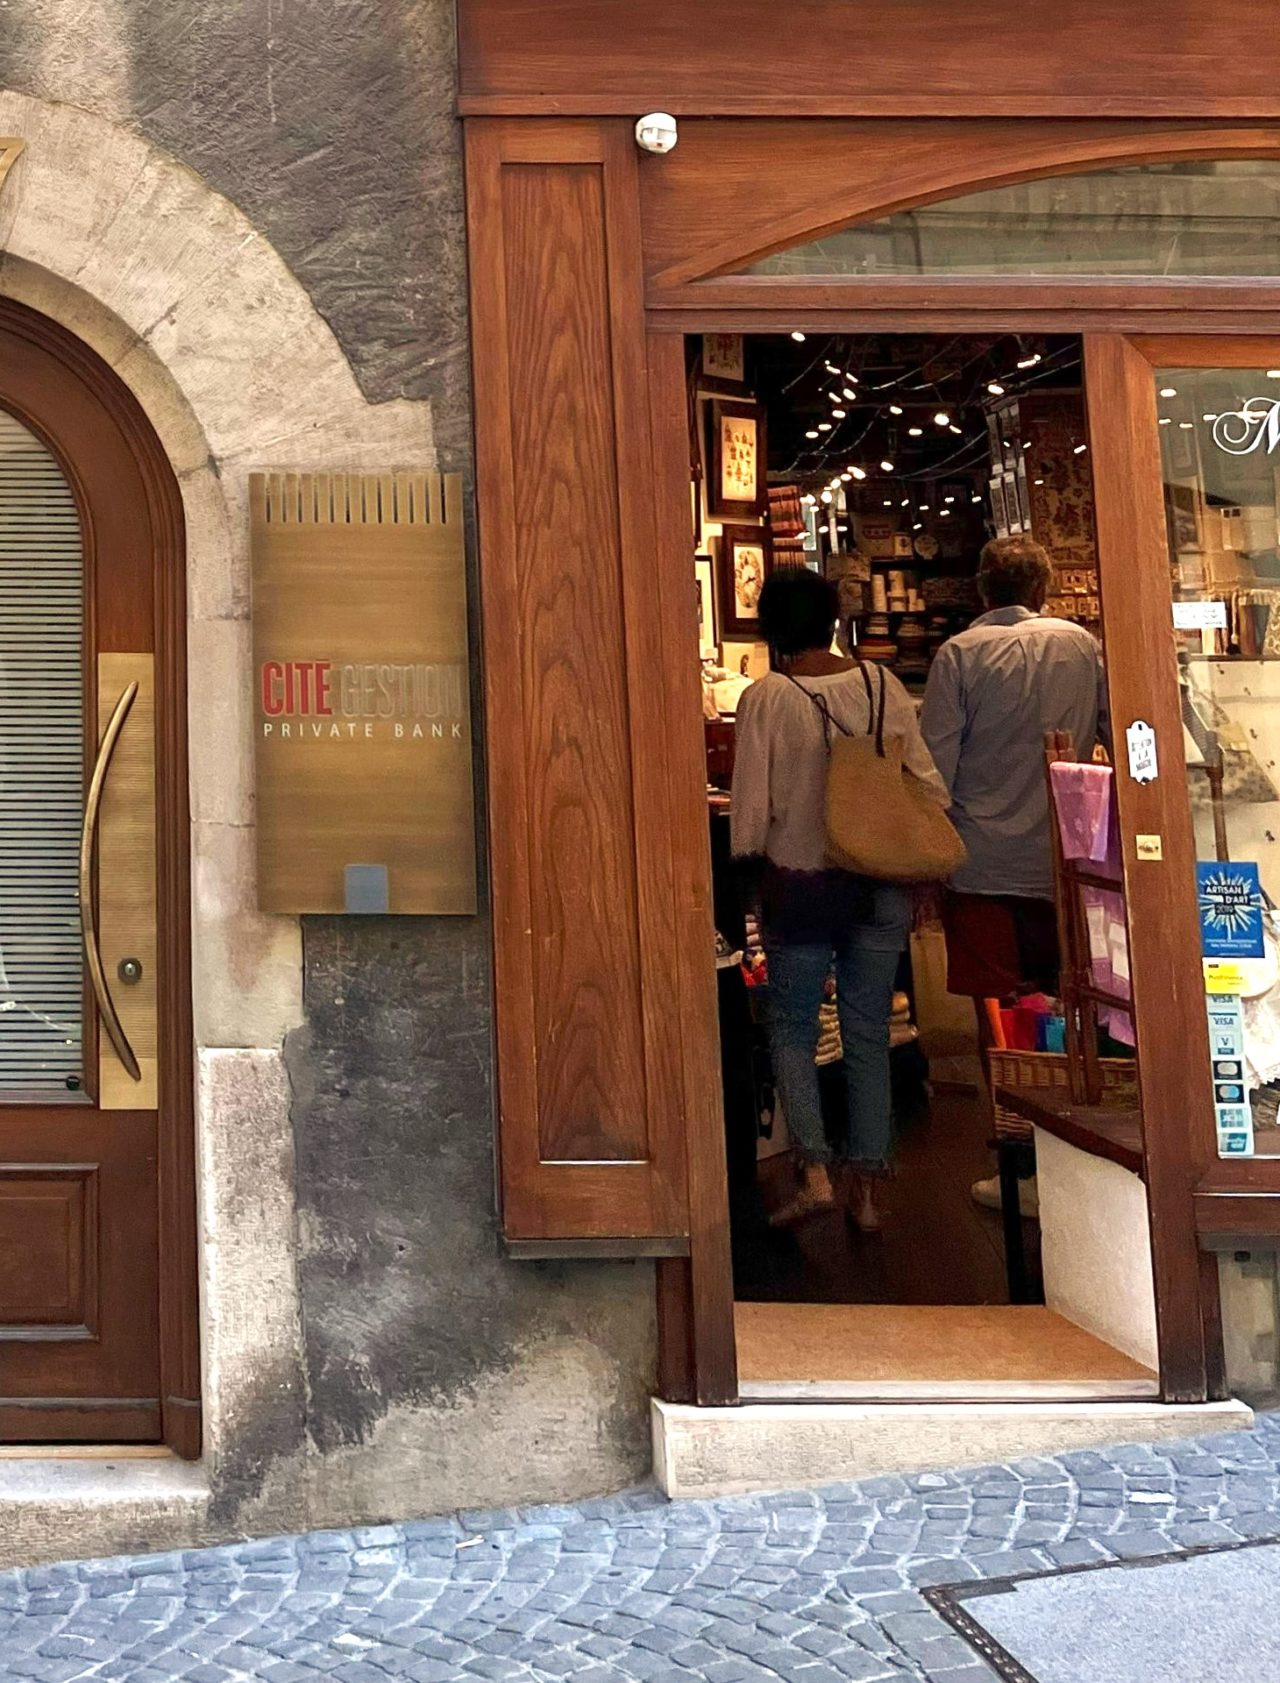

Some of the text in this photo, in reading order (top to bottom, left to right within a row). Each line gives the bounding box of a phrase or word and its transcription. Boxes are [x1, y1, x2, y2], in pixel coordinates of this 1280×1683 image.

[263, 722, 462, 738] PRIVATE BANK
[1206, 886, 1242, 895] ARTISAN
[1213, 1017, 1234, 1025] VISA
